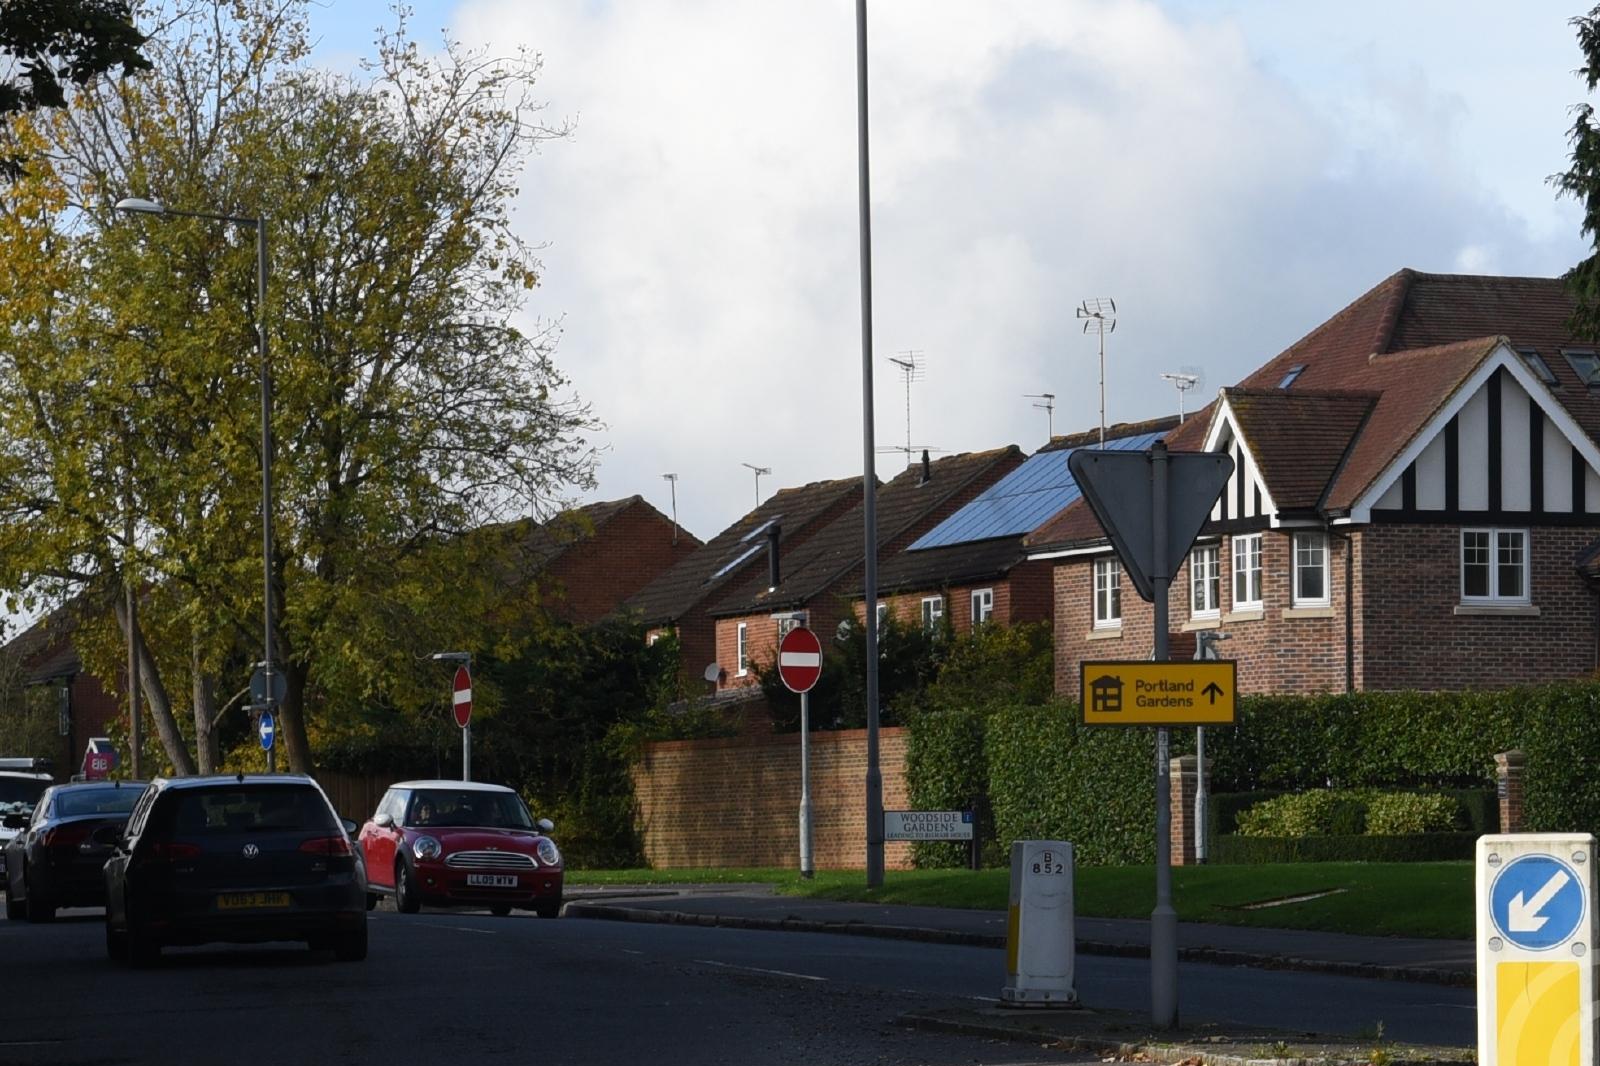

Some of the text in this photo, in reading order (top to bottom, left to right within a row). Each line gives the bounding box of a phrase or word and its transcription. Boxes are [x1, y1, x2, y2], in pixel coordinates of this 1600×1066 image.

[1135, 679, 1194, 692] Portland
[1135, 695, 1194, 708] Gardens
[900, 813, 959, 822] WOODSIDE
[903, 822, 955, 832] GARDENS
[1044, 852, 1052, 862] B
[1032, 863, 1063, 874] 852
